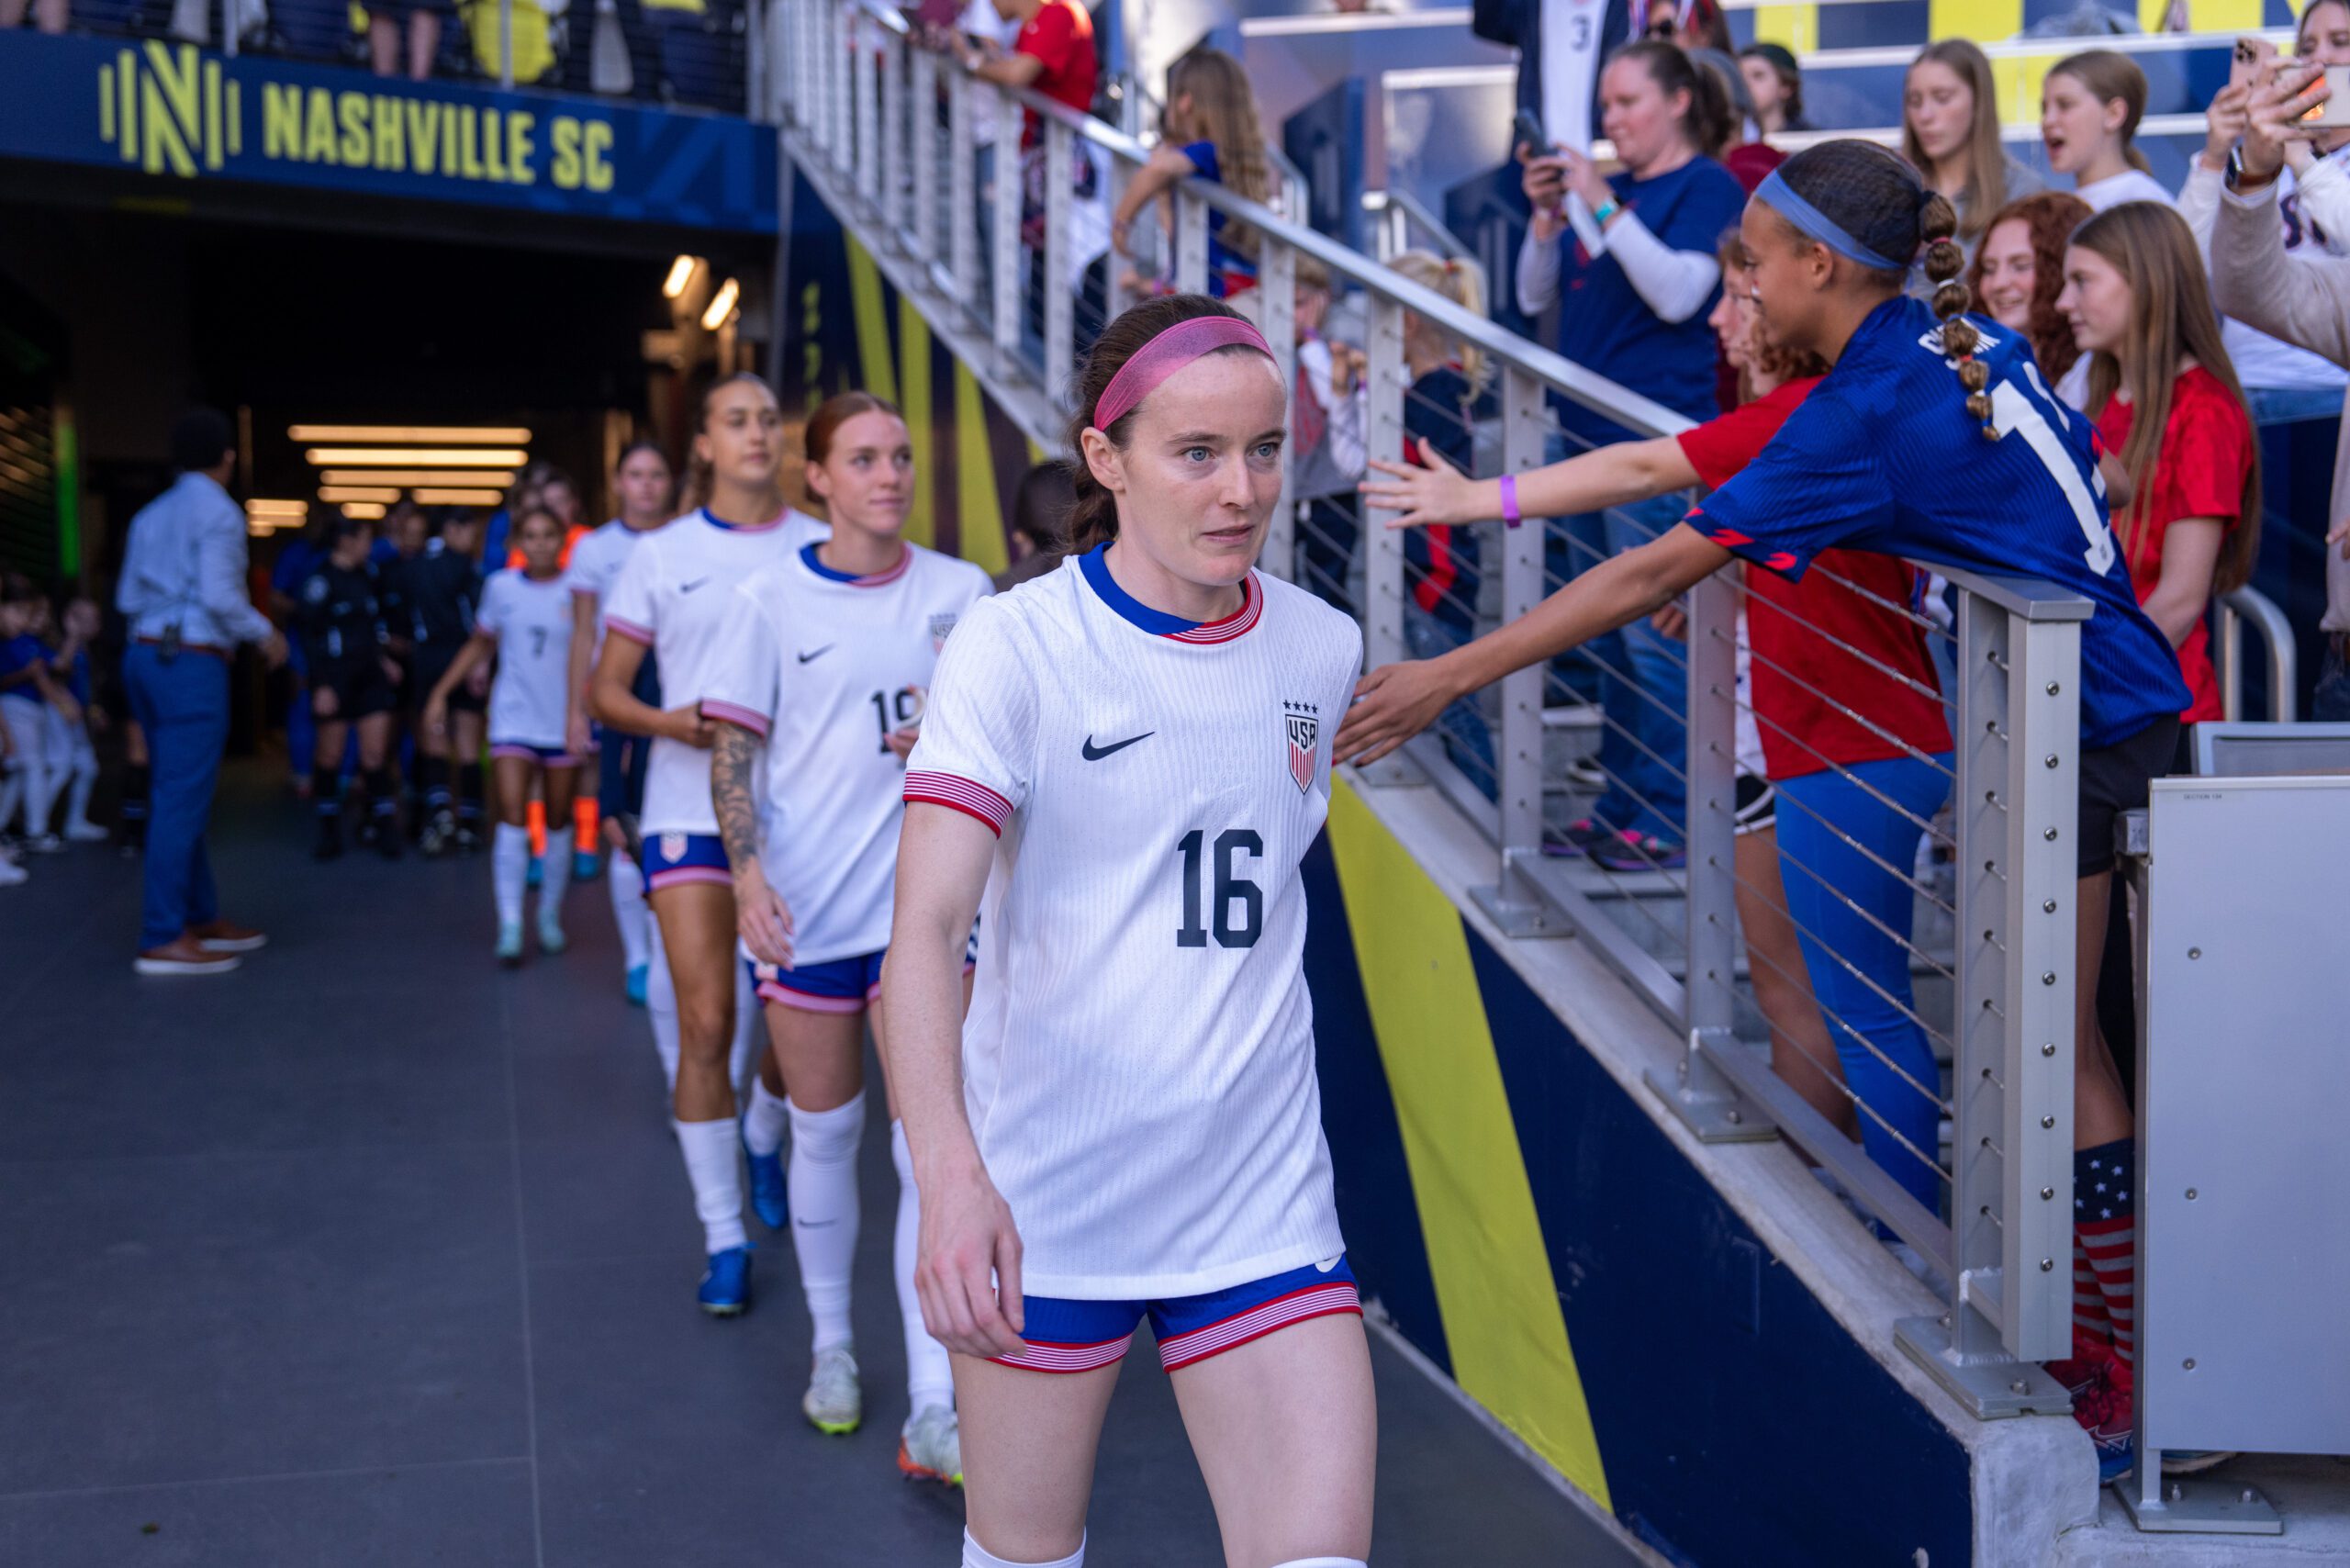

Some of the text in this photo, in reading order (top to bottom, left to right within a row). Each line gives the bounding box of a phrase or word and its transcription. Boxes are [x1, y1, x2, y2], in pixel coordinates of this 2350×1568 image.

[262, 81, 614, 192] NASHVILLE SC
[1289, 720, 1315, 749] USA
[1177, 829, 1263, 948] 16
